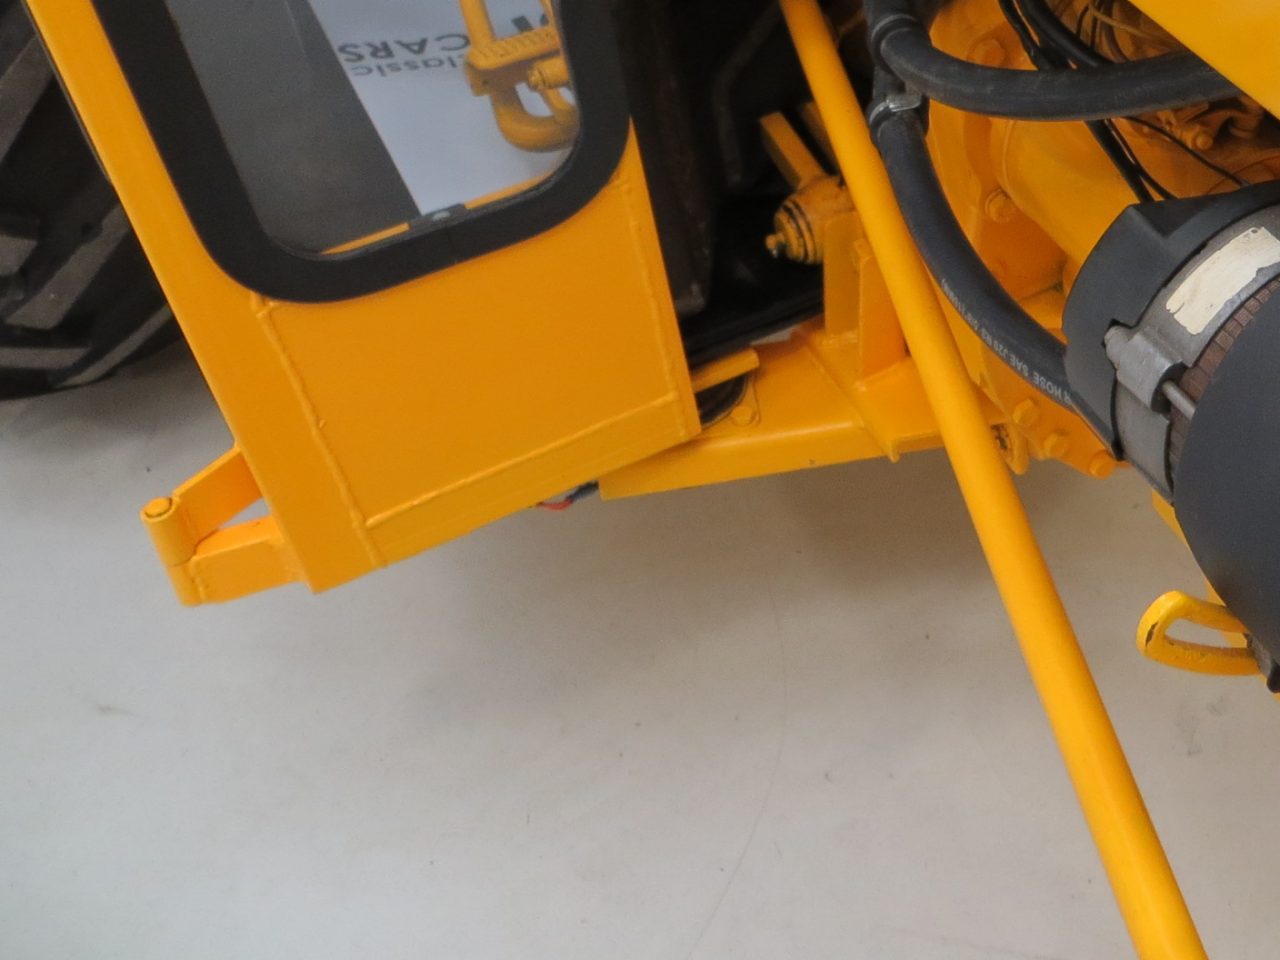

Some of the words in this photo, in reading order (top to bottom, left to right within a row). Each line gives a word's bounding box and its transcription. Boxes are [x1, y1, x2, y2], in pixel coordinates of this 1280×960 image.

[337, 33, 471, 63] CARS
[1010, 355, 1029, 378] SAE
[1032, 371, 1062, 402] HOSE
